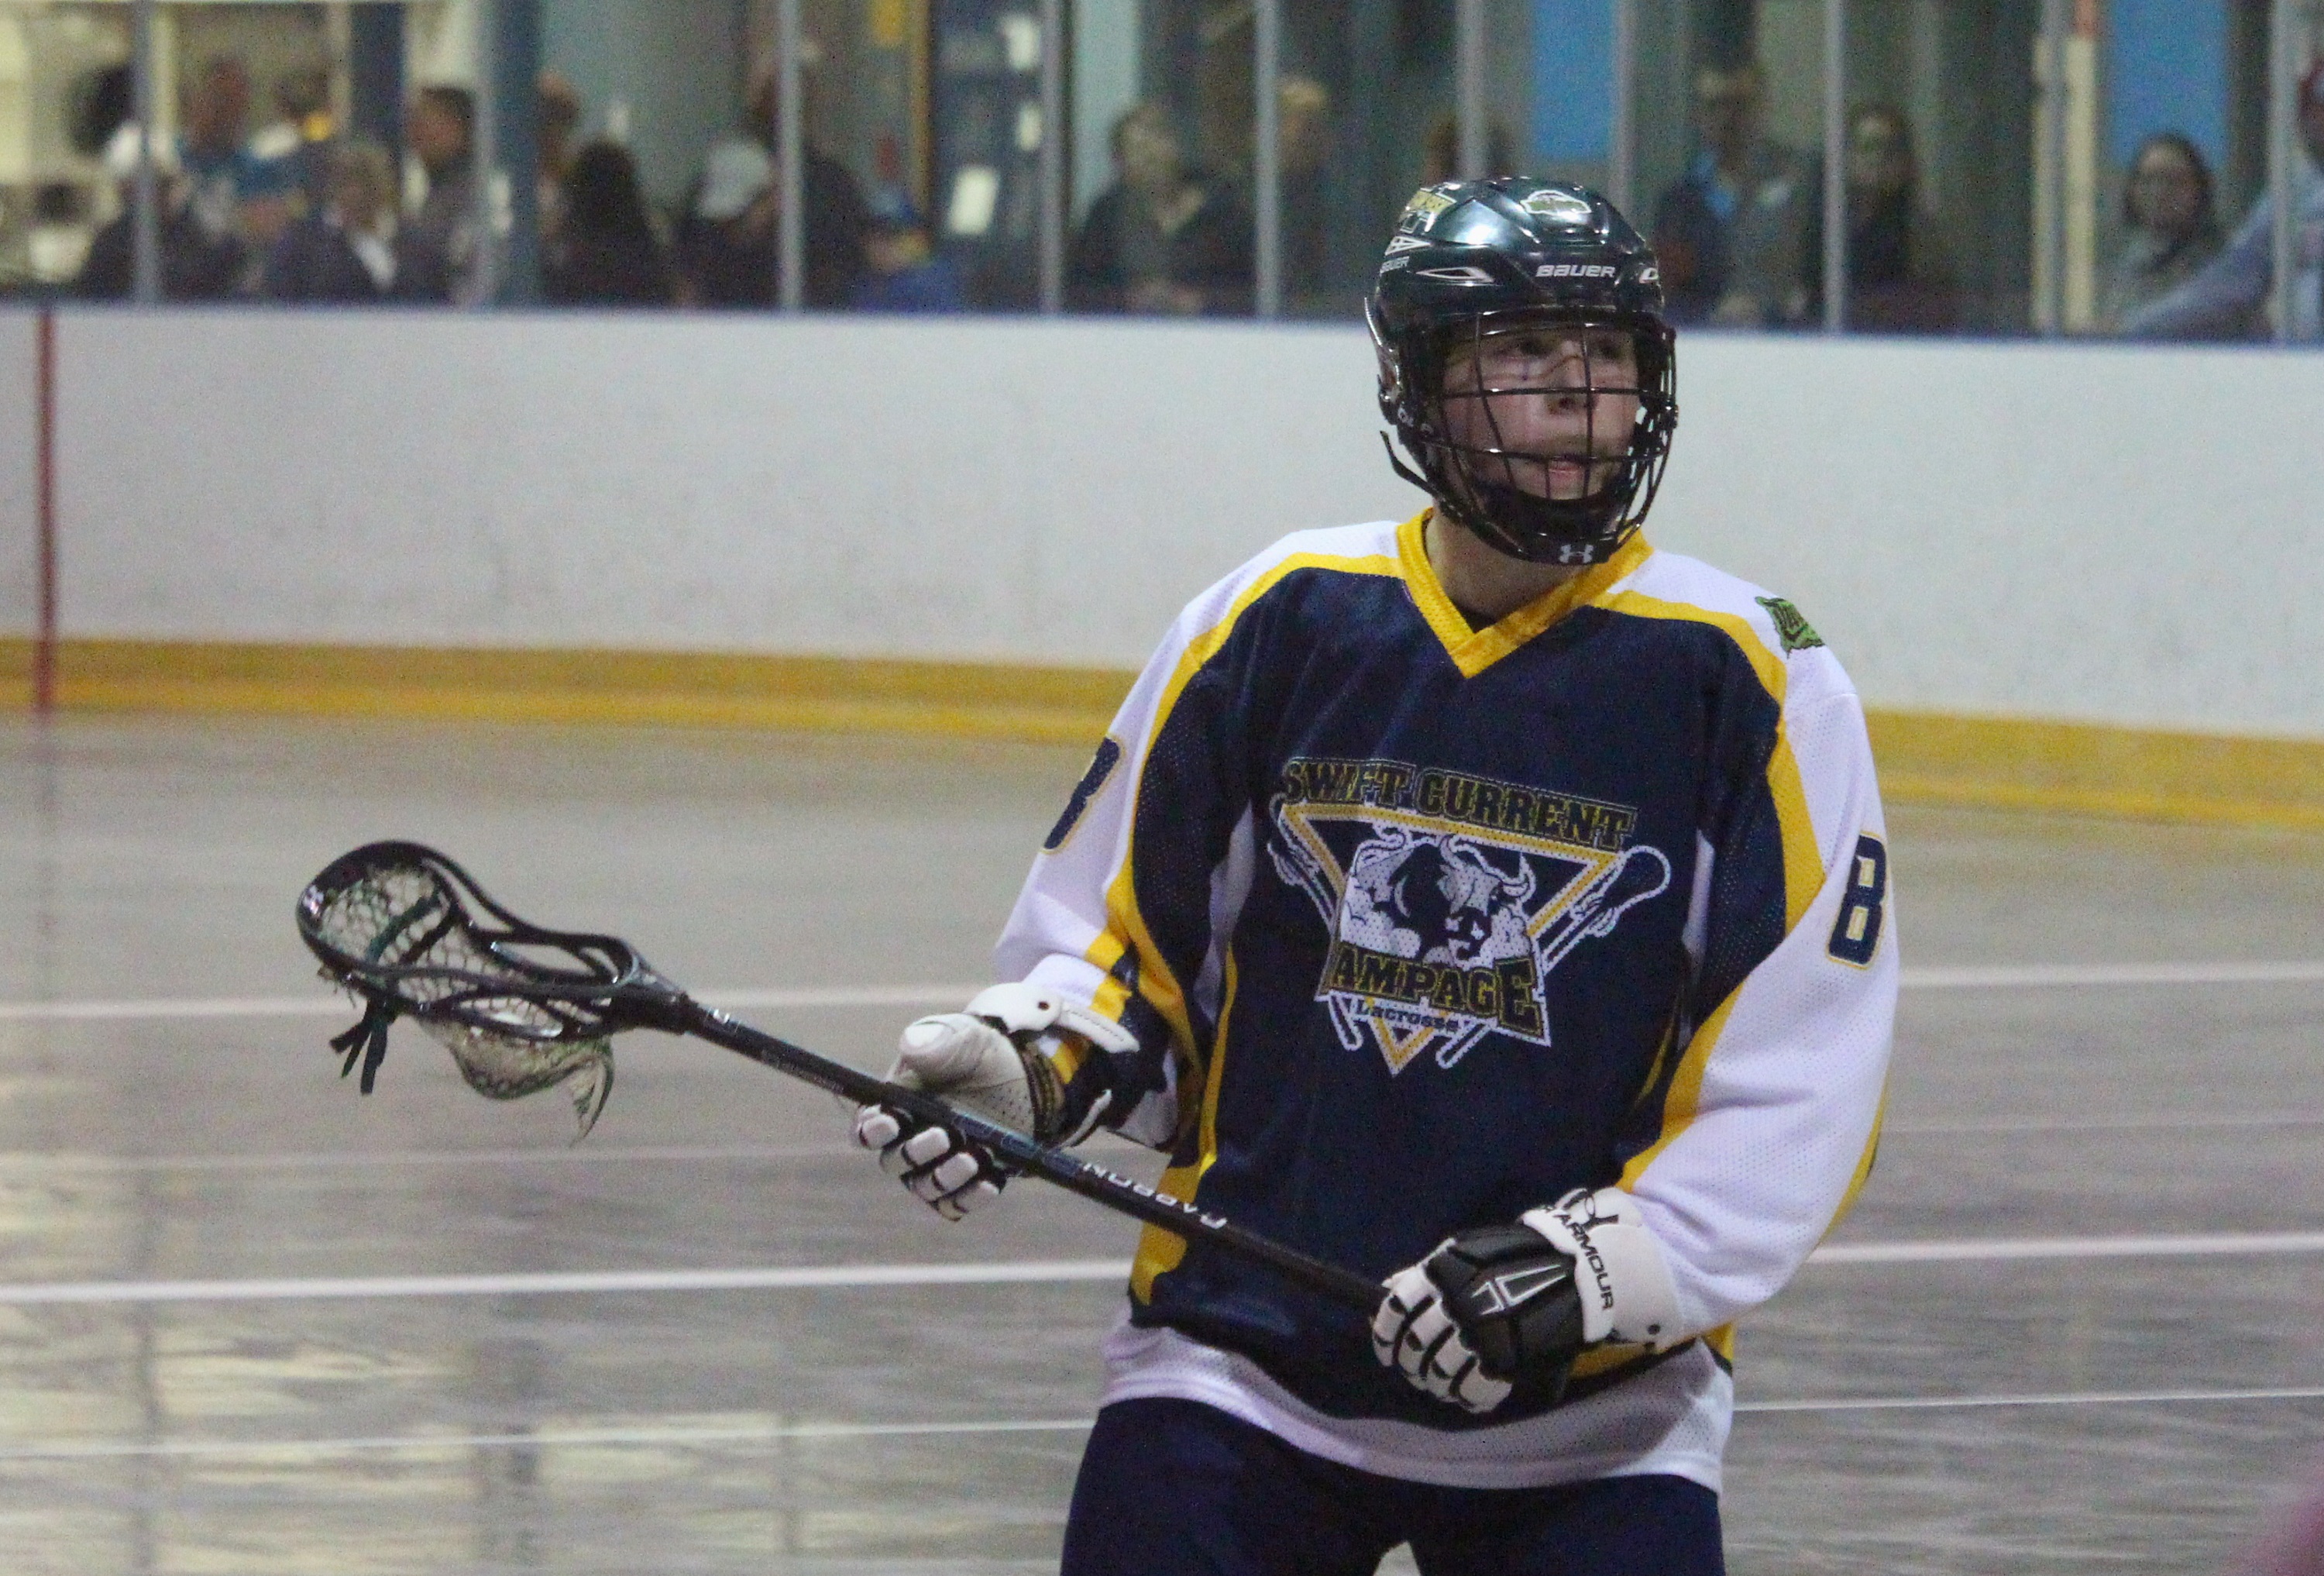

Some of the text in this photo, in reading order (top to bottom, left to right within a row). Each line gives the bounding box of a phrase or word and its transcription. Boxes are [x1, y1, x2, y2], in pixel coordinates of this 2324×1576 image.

[1535, 264, 1616, 277] BAUER
[1418, 768, 1637, 852] CURRENT
[1825, 831, 1889, 969] 8
[1323, 942, 1545, 1038] AMPAGE
[1552, 1213, 1614, 1309] ARMOUR
